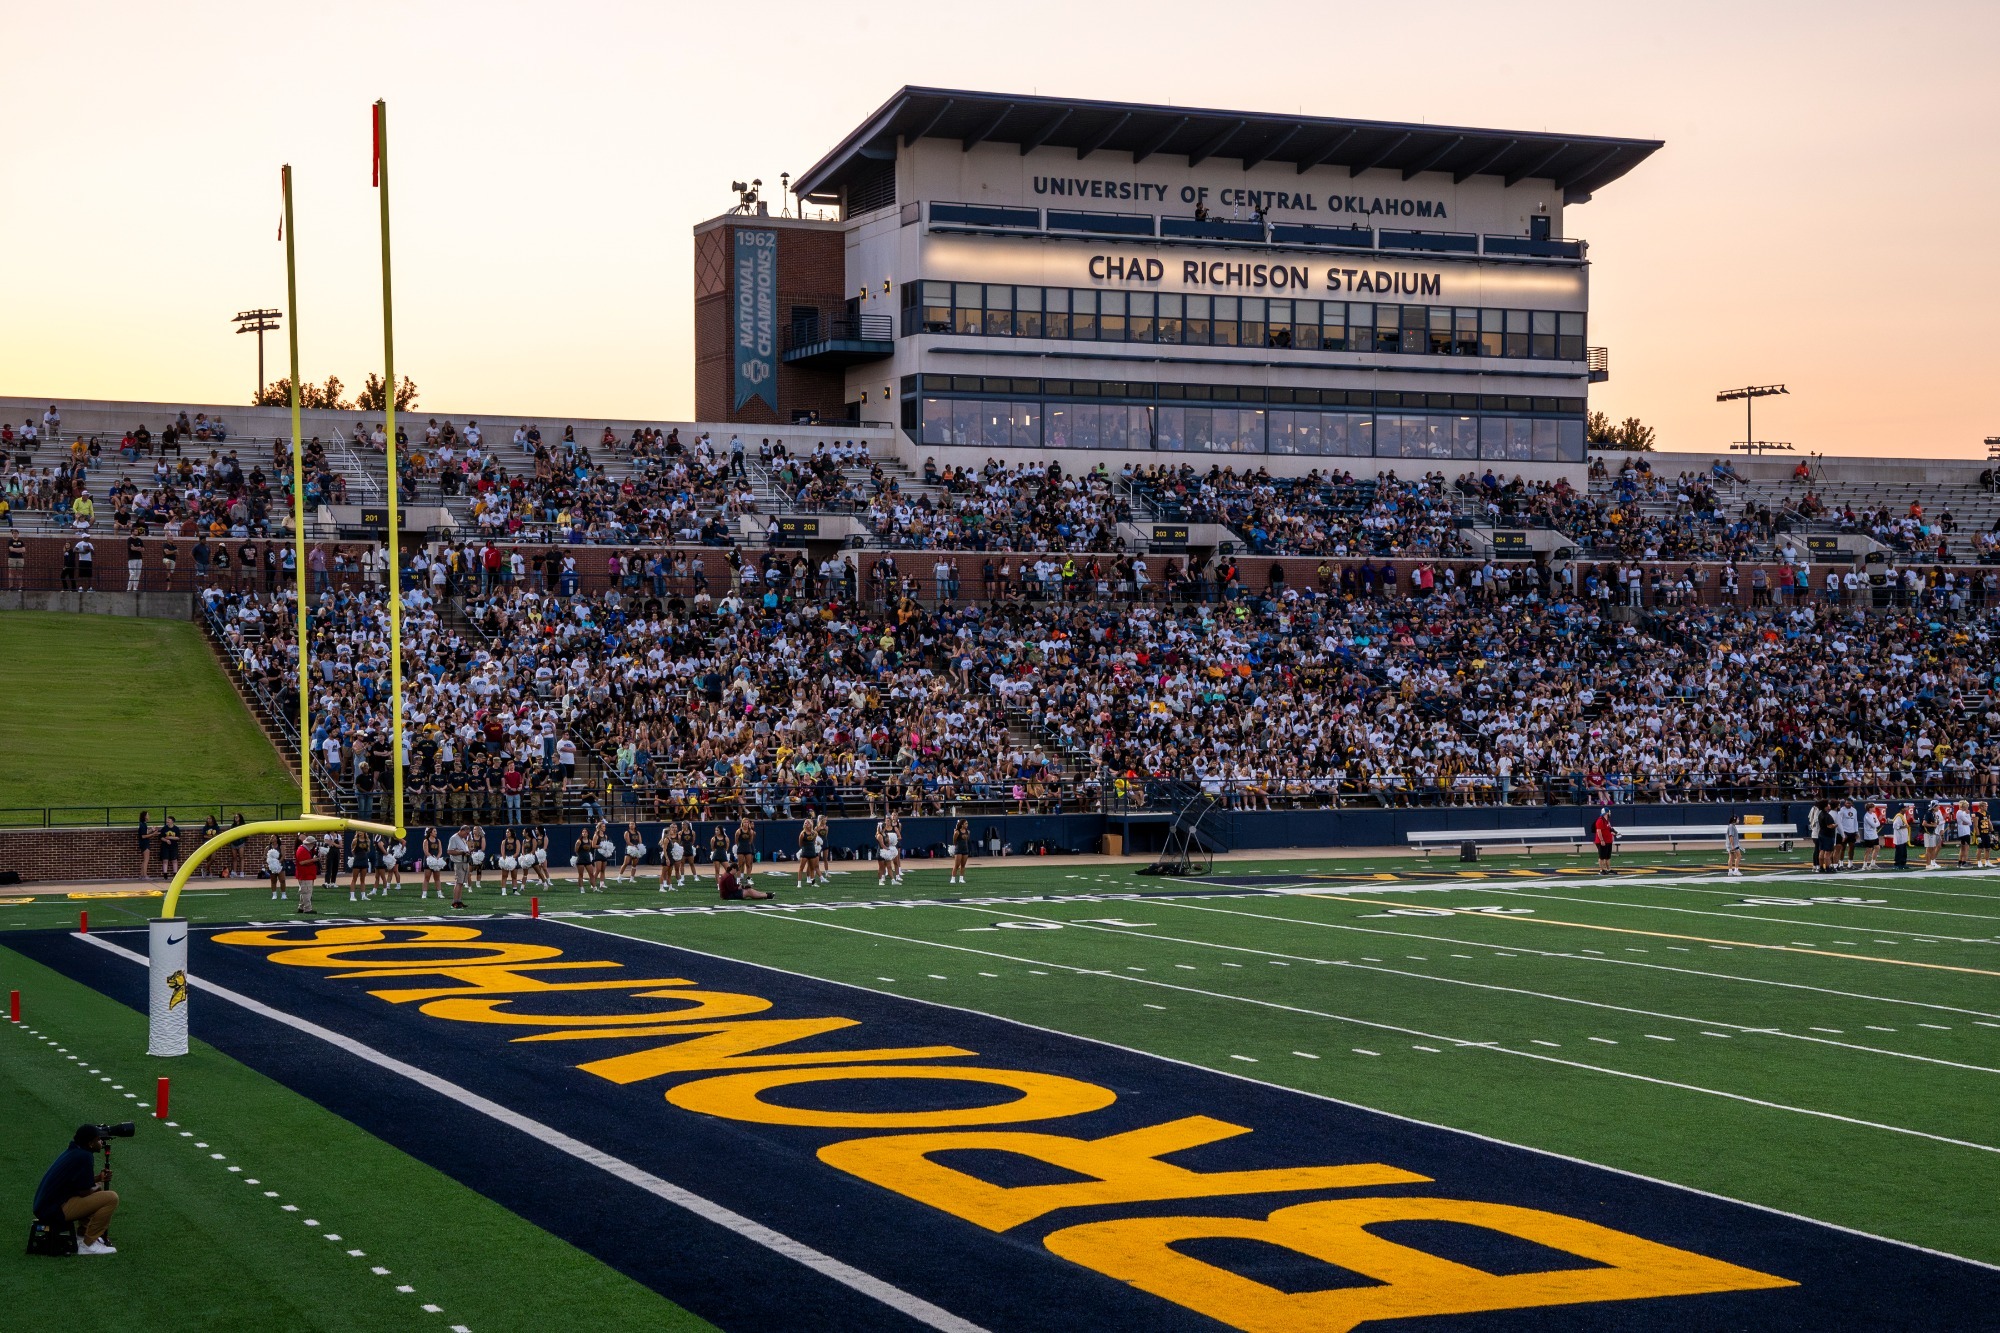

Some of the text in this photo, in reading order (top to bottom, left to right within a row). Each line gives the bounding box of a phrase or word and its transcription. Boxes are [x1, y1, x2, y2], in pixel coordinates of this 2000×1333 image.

[1033, 175, 1447, 219] UNIVERSITY OF CENTRAL OKLAHOMA
[736, 231, 776, 247] 1962
[1089, 255, 1441, 296] CHAD RICHISON STADIUM
[740, 256, 754, 348] NATIONAL
[757, 248, 772, 357] CHAMPIONS
[364, 514, 378, 522] 201
[803, 523, 816, 531] 203
[1155, 530, 1167, 538] 203
[210, 925, 1801, 1333] BRONCHOS
